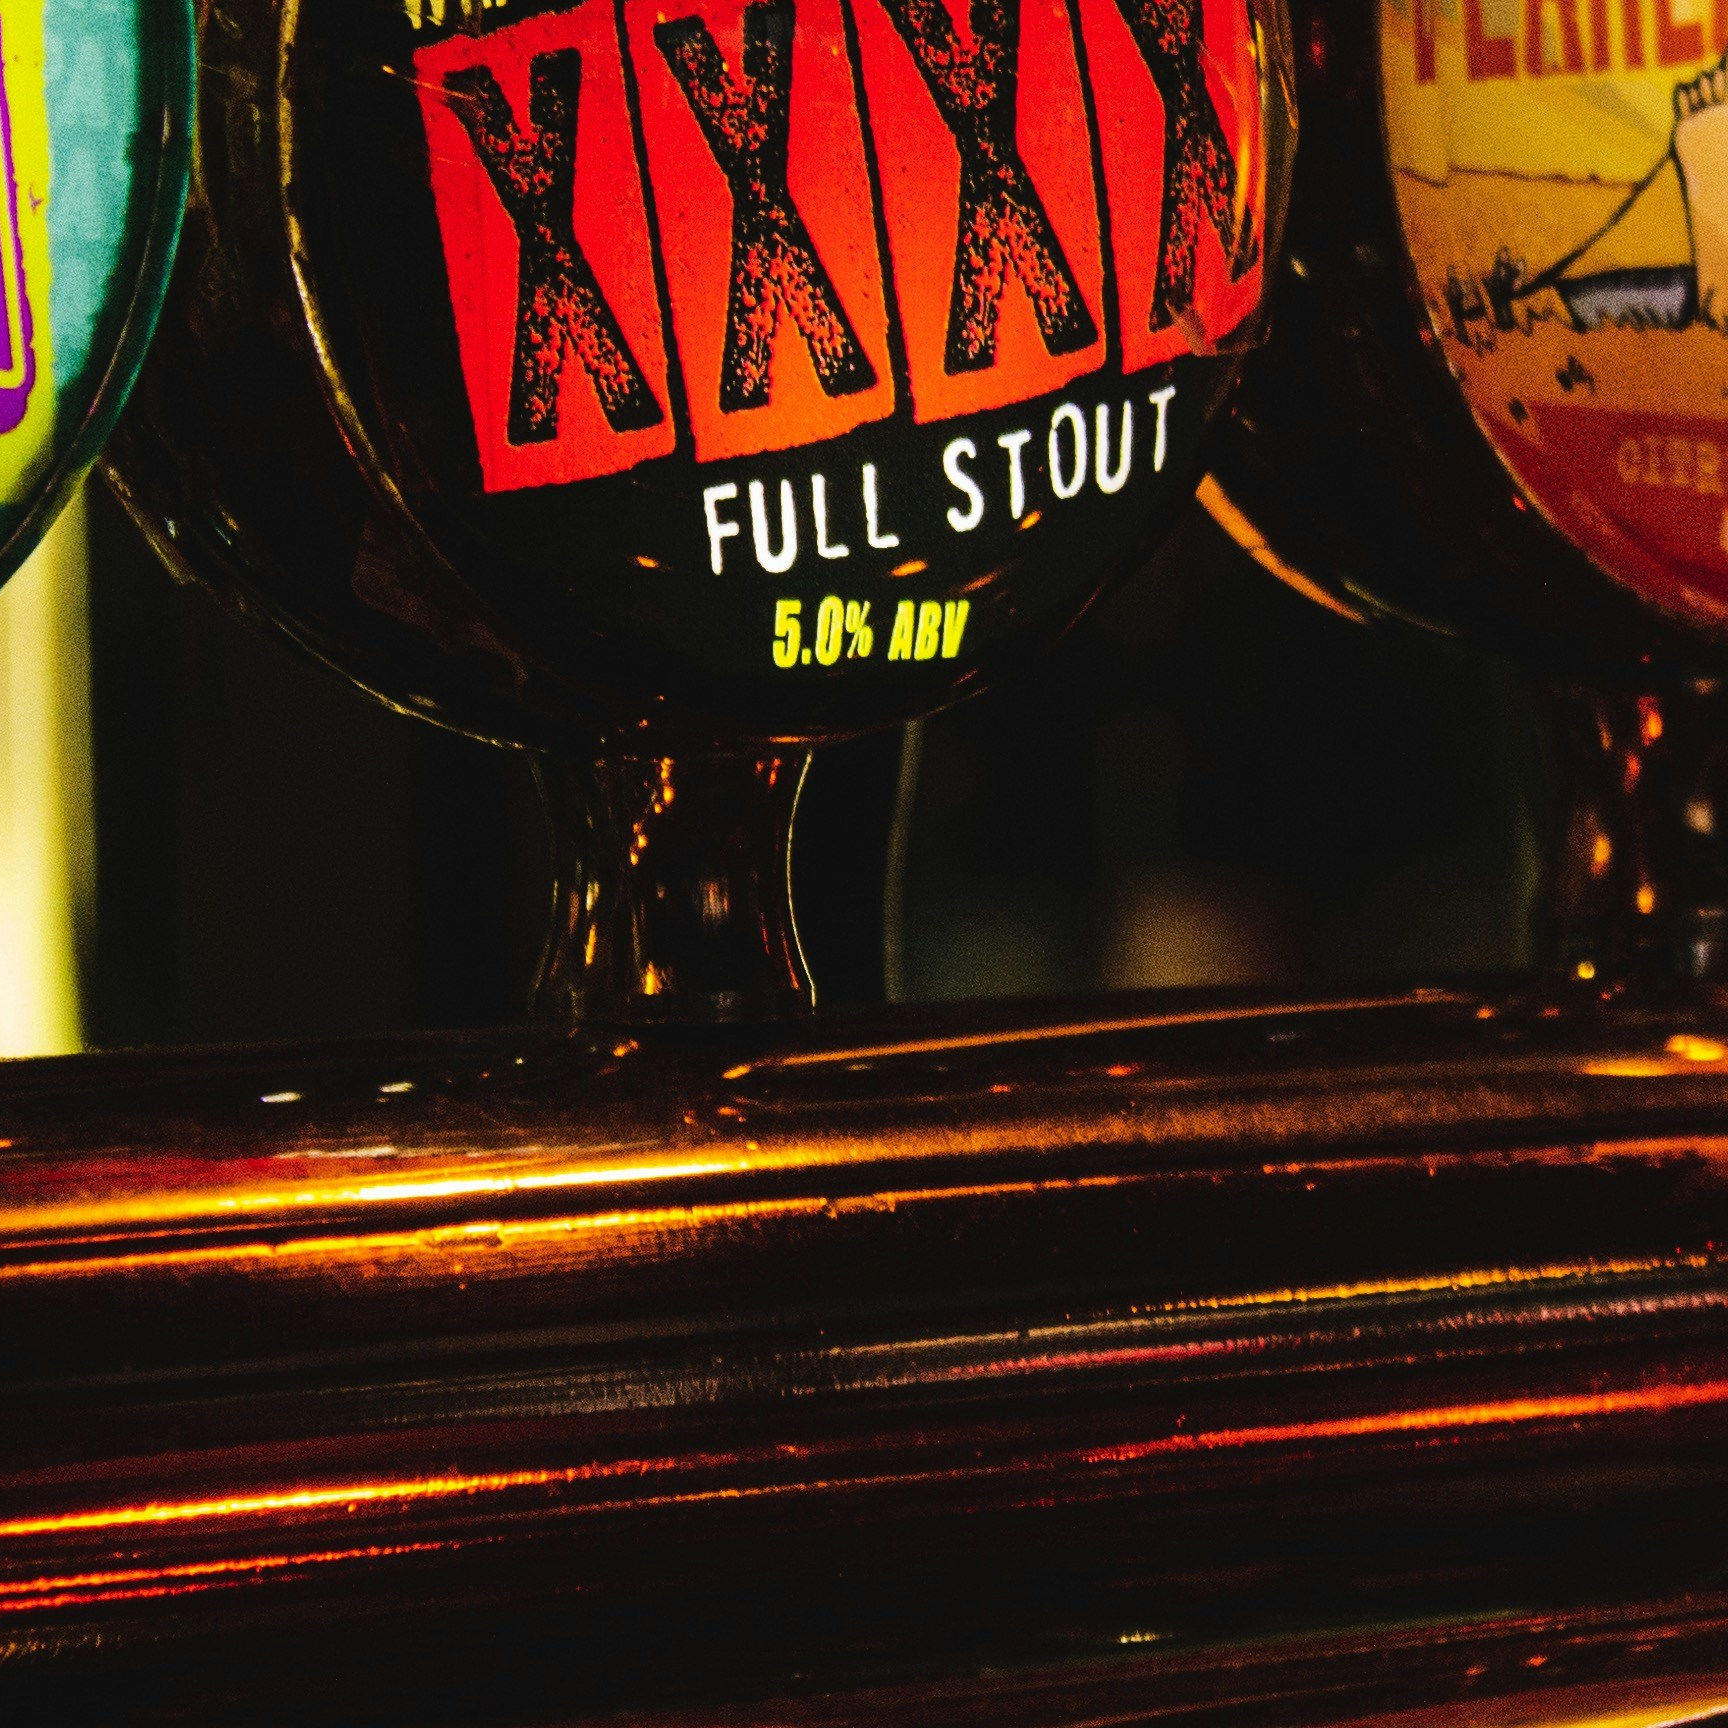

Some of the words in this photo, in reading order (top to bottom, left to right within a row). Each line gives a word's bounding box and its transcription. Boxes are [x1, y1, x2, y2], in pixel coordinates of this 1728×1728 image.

[702, 462, 901, 576] FULL
[941, 384, 1178, 534] STOUT
[772, 594, 874, 669] 5.0%
[886, 598, 972, 663] ABV
